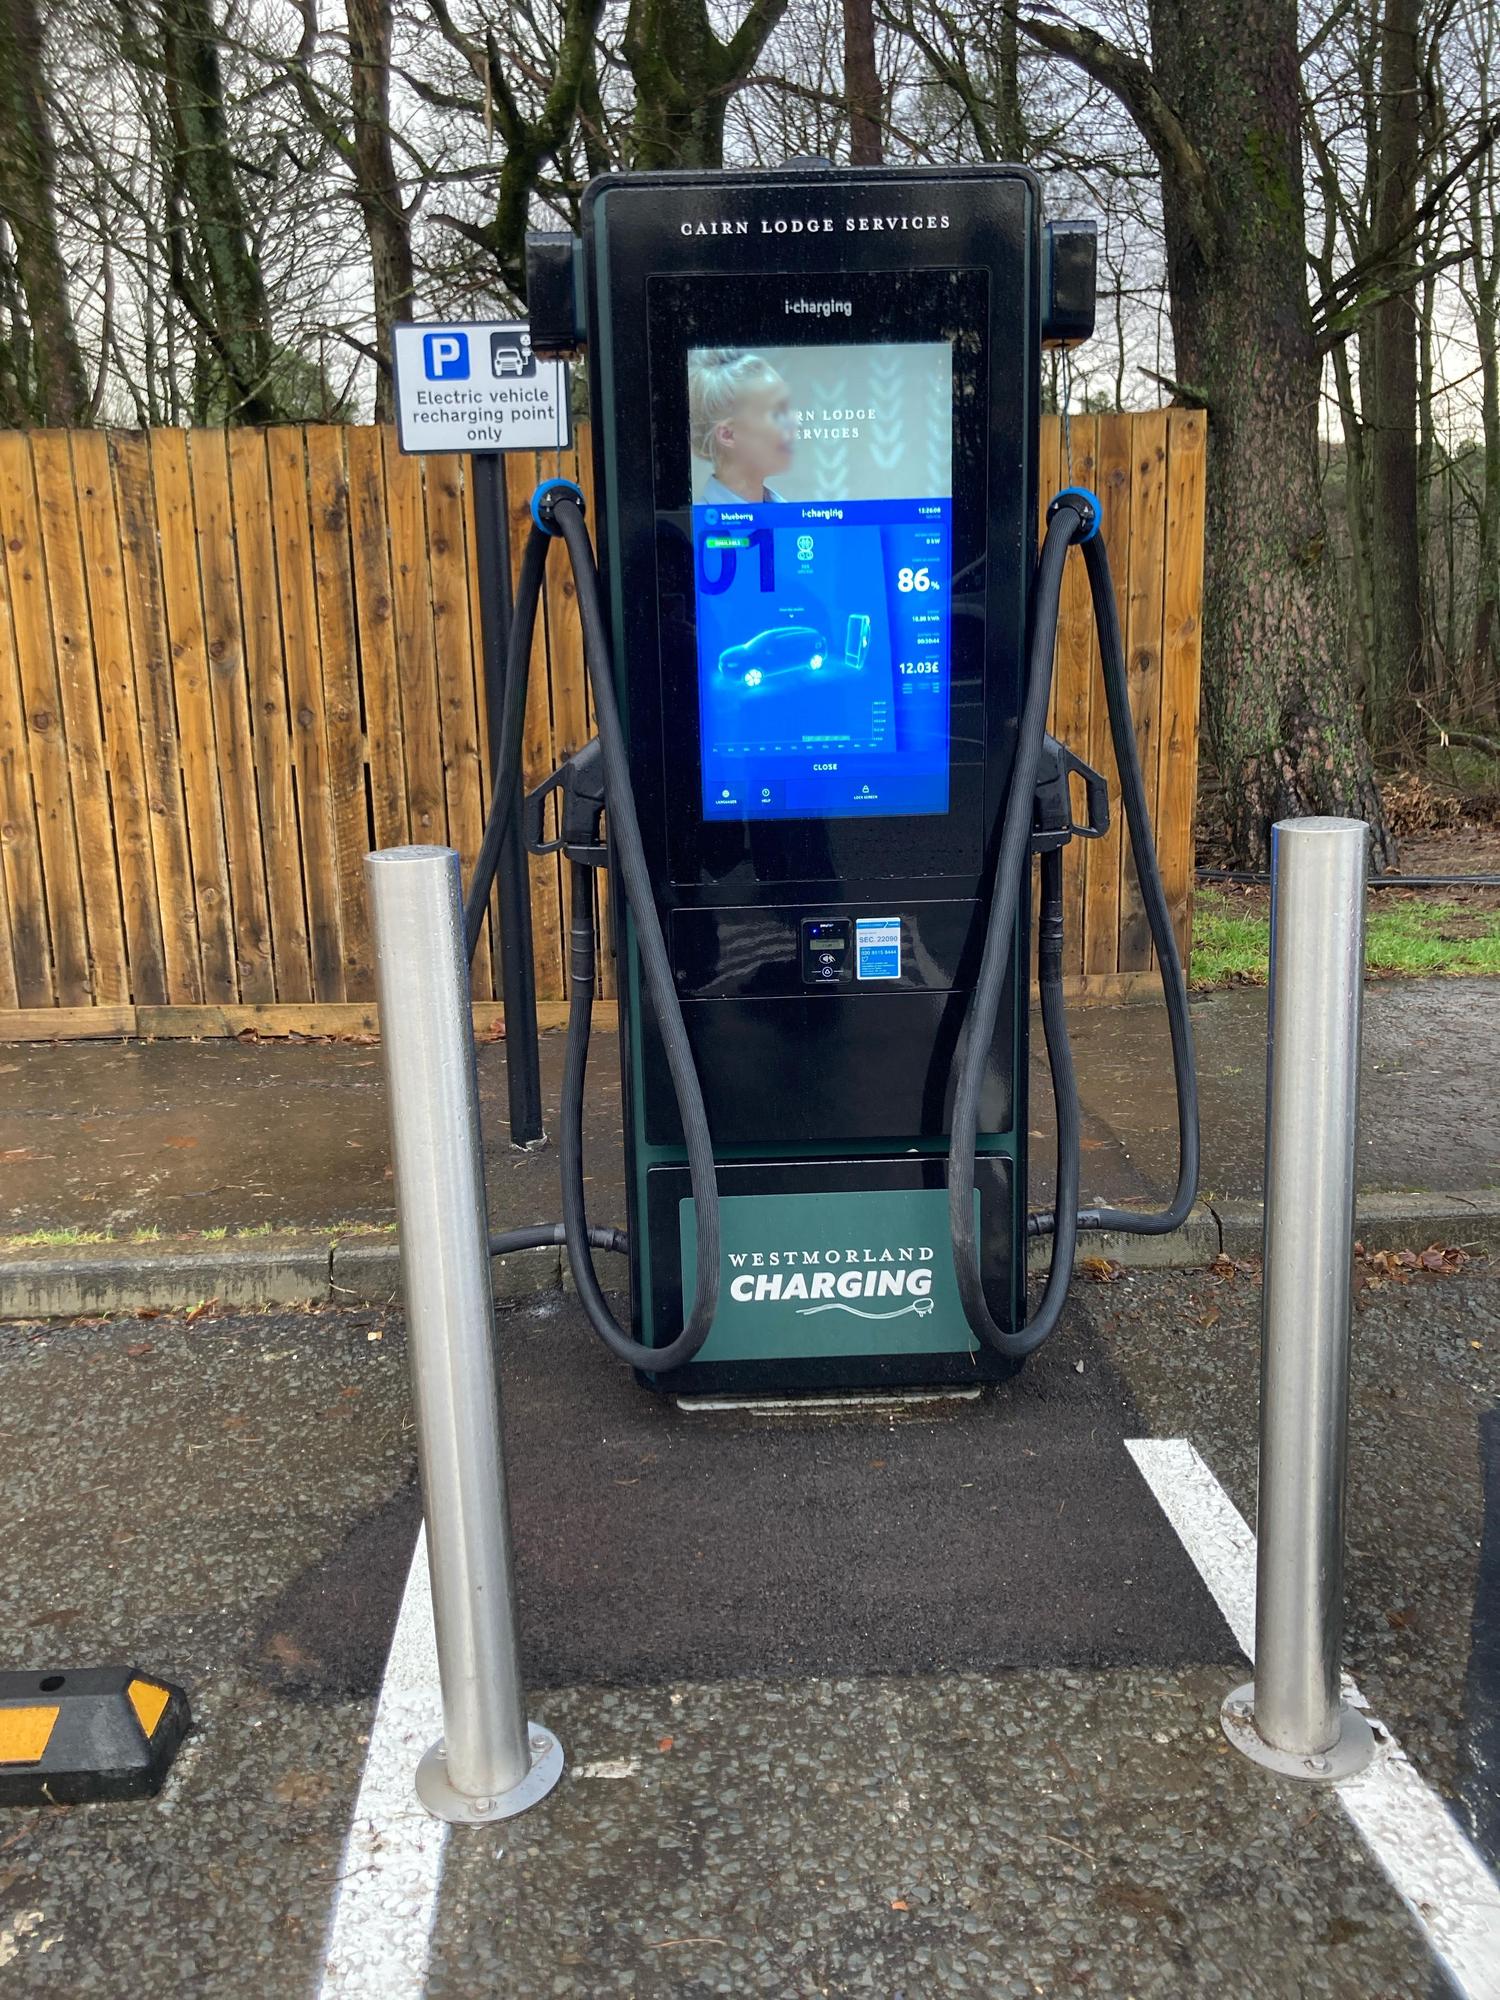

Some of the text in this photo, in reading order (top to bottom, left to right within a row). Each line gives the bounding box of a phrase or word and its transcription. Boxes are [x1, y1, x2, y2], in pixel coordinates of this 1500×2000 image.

[680, 216, 950, 236] CAIRN LODGE SERVICES
[431, 337, 460, 377] P
[417, 388, 549, 405] Electric vehicle
[413, 406, 555, 424] recharging point
[823, 409, 877, 421] LODGE
[467, 426, 503, 442] only
[796, 427, 860, 440] RVICES
[721, 512, 754, 522] blueberry
[813, 763, 838, 771] CLOSE
[728, 1247, 934, 1267] WESTMORLAND
[730, 1268, 933, 1302] CHARGING
